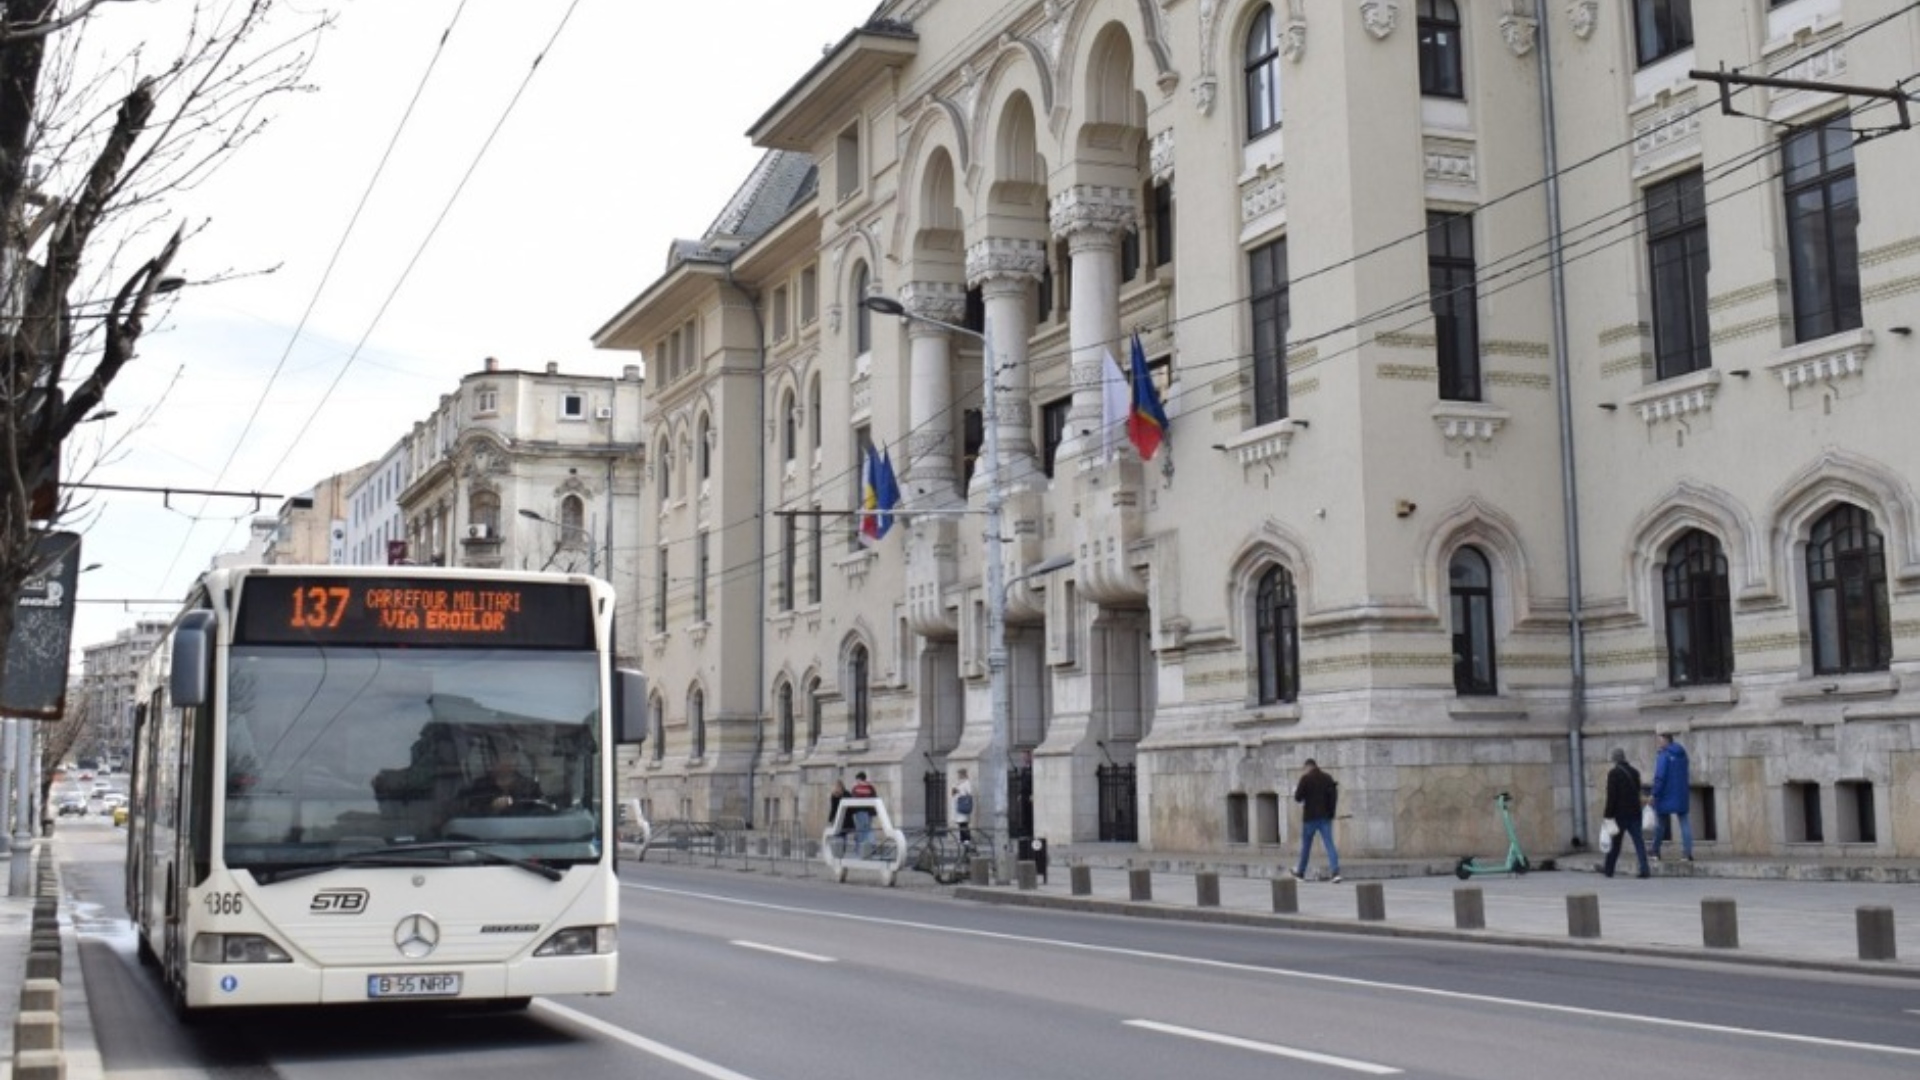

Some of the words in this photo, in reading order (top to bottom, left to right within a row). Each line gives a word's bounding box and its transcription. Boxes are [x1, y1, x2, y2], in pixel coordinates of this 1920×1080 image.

[291, 586, 350, 627] 137
[366, 589, 448, 610] CARREFOUR
[453, 590, 521, 612] MILITARI
[382, 609, 419, 629] VIA
[426, 610, 506, 630] EROILOR
[310, 893, 363, 910] STB
[380, 978, 391, 993] B
[420, 977, 454, 992] NRP
